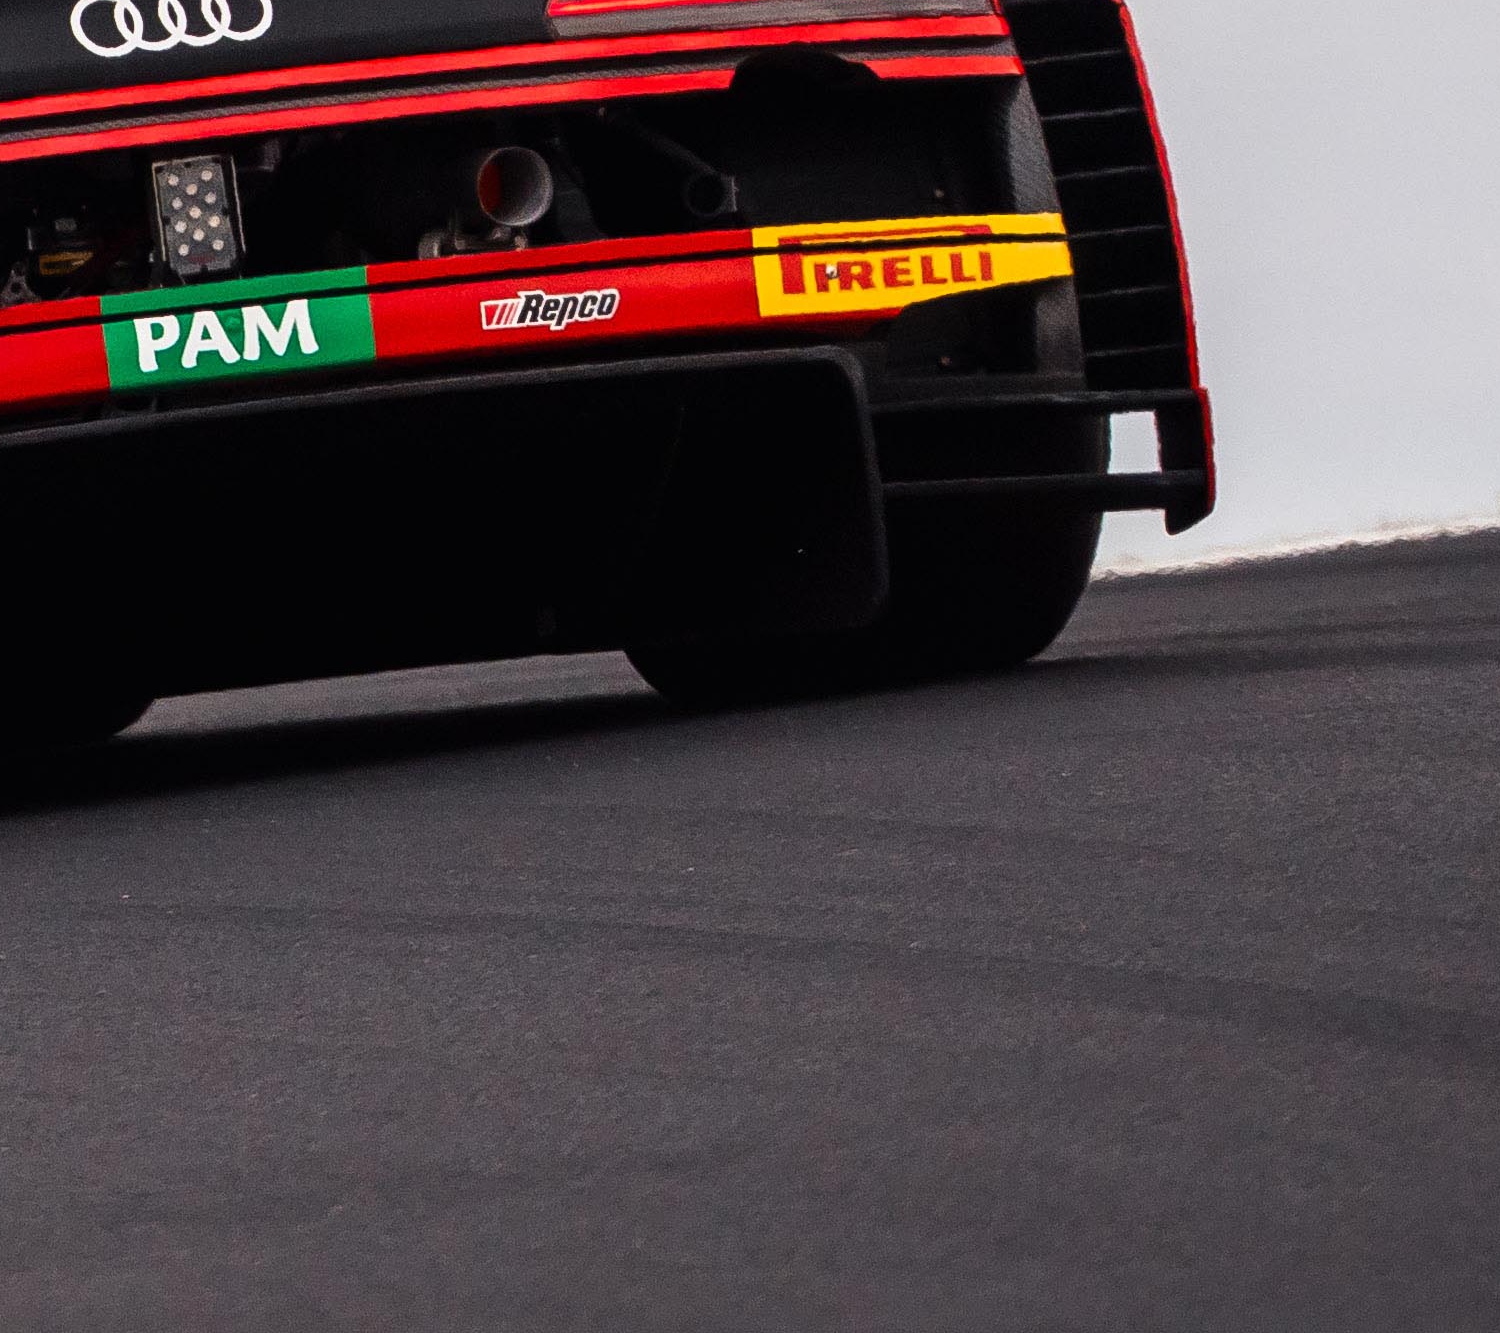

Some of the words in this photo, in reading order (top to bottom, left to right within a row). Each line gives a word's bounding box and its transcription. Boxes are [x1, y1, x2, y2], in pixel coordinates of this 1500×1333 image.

[778, 225, 992, 293] PIRELLI
[132, 299, 320, 372] PAM
[518, 290, 617, 328] Repco
